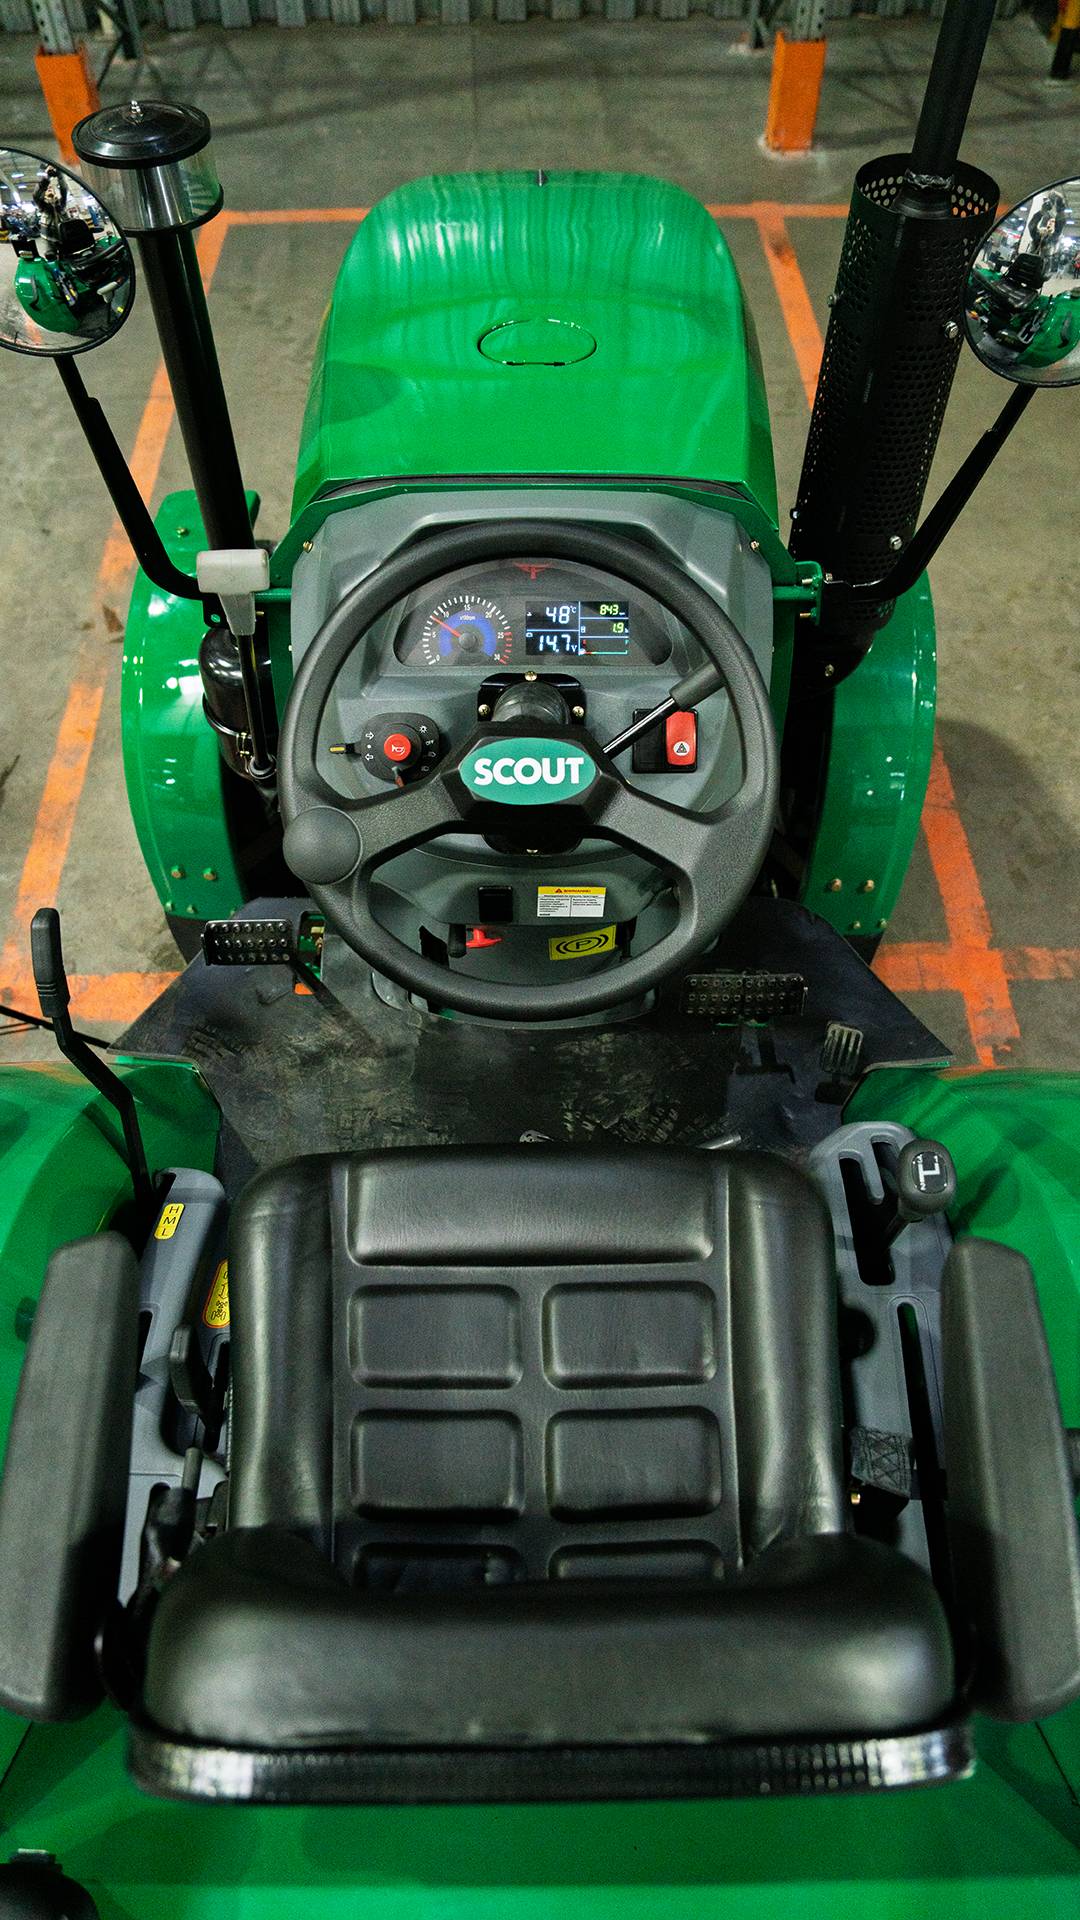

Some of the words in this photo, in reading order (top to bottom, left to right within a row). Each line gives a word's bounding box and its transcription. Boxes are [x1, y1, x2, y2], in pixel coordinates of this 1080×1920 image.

[545, 605, 570, 624] 48
[600, 604, 619, 615] 843
[497, 631, 504, 639] 25
[539, 633, 571, 653] 14.7
[494, 653, 501, 661] 30
[474, 757, 584, 786] SCOUT
[920, 1182, 926, 1190] 2
